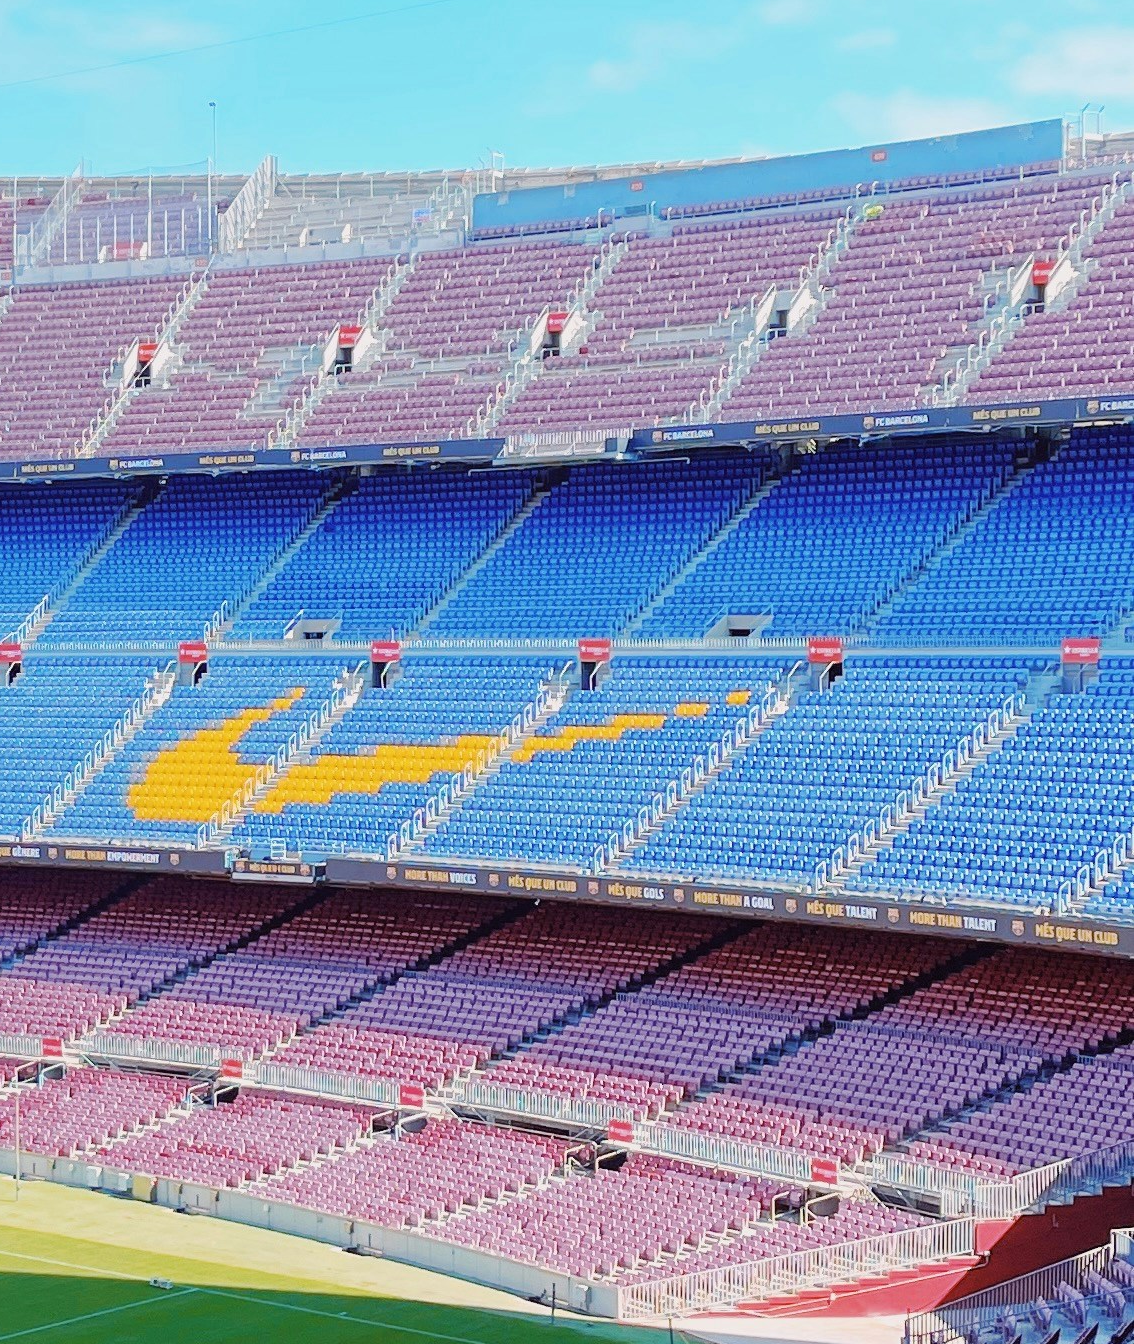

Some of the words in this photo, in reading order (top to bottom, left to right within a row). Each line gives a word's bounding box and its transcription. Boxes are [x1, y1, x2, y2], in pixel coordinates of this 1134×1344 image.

[1100, 402, 1111, 411] FC
[973, 409, 990, 420] MÉS
[991, 410, 1007, 420] QUE
[1008, 409, 1019, 418] UN
[1020, 408, 1040, 417] CLUB
[875, 418, 885, 426] FC
[885, 415, 928, 426] BARCELONA
[755, 424, 771, 434] MÉS
[771, 424, 787, 434] QUE
[788, 424, 799, 432] UN
[800, 422, 820, 431] CLUB
[663, 432, 672, 440] FC
[673, 430, 714, 439] BARCELONA
[301, 453, 310, 461] FC
[383, 447, 397, 456] MÉS
[398, 447, 410, 456] QUE
[119, 460, 128, 468] FC
[199, 455, 213, 464] MÉS
[214, 456, 226, 465] QUE
[21, 464, 35, 473] MÉS
[36, 465, 48, 474] QUE
[65, 849, 86, 860] MORE
[86, 850, 106, 860] THAN
[107, 851, 160, 863] EMPOWERMENT
[404, 869, 426, 881] MORE
[427, 870, 448, 882] THAN
[450, 871, 477, 884] VOICES
[508, 875, 524, 888] MÉS
[525, 878, 542, 890] QUE
[543, 879, 555, 891] UN
[556, 880, 577, 893] CLUB
[608, 883, 624, 896] MÉS
[625, 886, 643, 899] QUE
[643, 887, 665, 900] GOLS
[693, 891, 719, 904] MORE
[719, 893, 742, 906] THAN
[743, 896, 751, 907] A
[751, 896, 775, 911] GOAL
[807, 900, 825, 915] MÉS
[825, 904, 845, 919] QUE
[845, 905, 878, 920] TALENT
[910, 911, 936, 925] MORE
[937, 914, 962, 928] THAN
[963, 916, 996, 932] TALENT
[1036, 922, 1055, 938] MÉS
[1056, 926, 1076, 942] QUE
[1077, 929, 1092, 943] UN
[1093, 931, 1118, 945] CLUB
